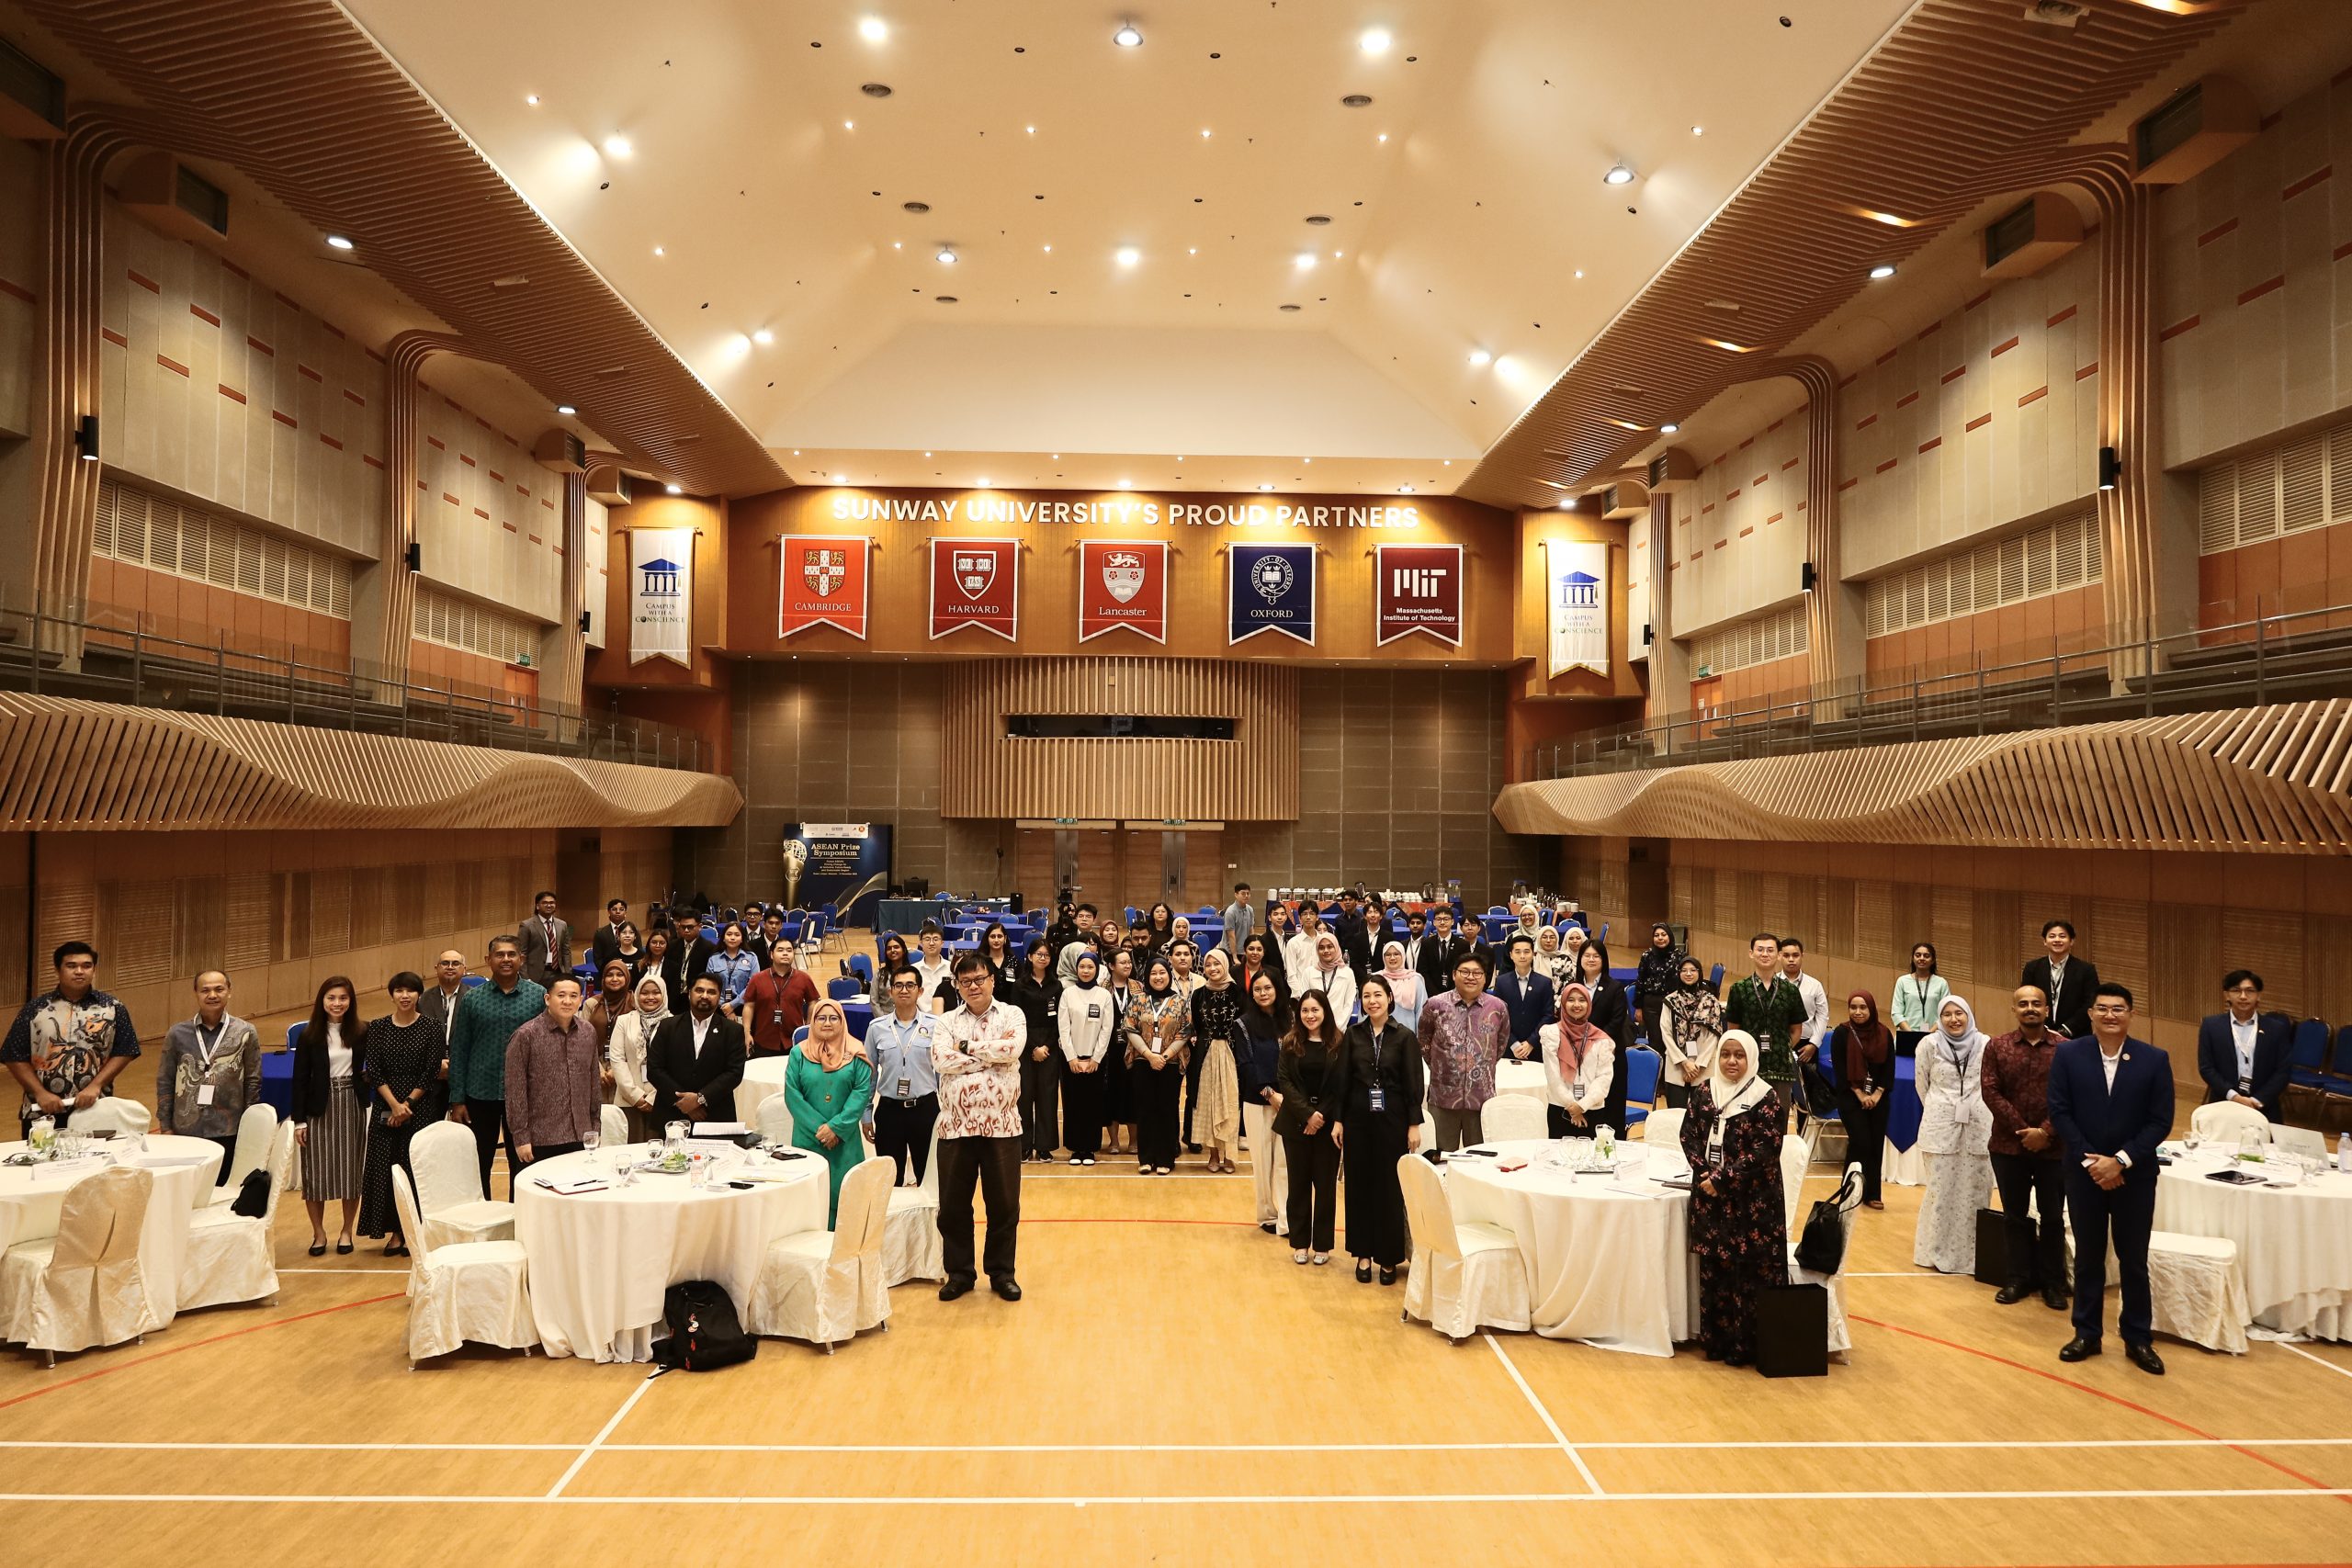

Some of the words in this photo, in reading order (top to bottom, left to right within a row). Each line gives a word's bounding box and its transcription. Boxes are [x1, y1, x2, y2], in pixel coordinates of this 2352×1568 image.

[832, 498, 958, 522] SUNWAY
[966, 500, 1159, 525] UNIVERSITY'S
[1169, 504, 1268, 526] PROUD
[1277, 505, 1419, 528] PARTNERS
[1252, 557, 1271, 589] UNIVERSITY
[795, 602, 852, 612] CAMBRIDGE
[948, 604, 1000, 614] HARVARD
[1099, 606, 1148, 616] Lancaster
[1250, 609, 1294, 618] OXFORD
[1419, 615, 1455, 623] Technology
[813, 849, 858, 857] Symposium
